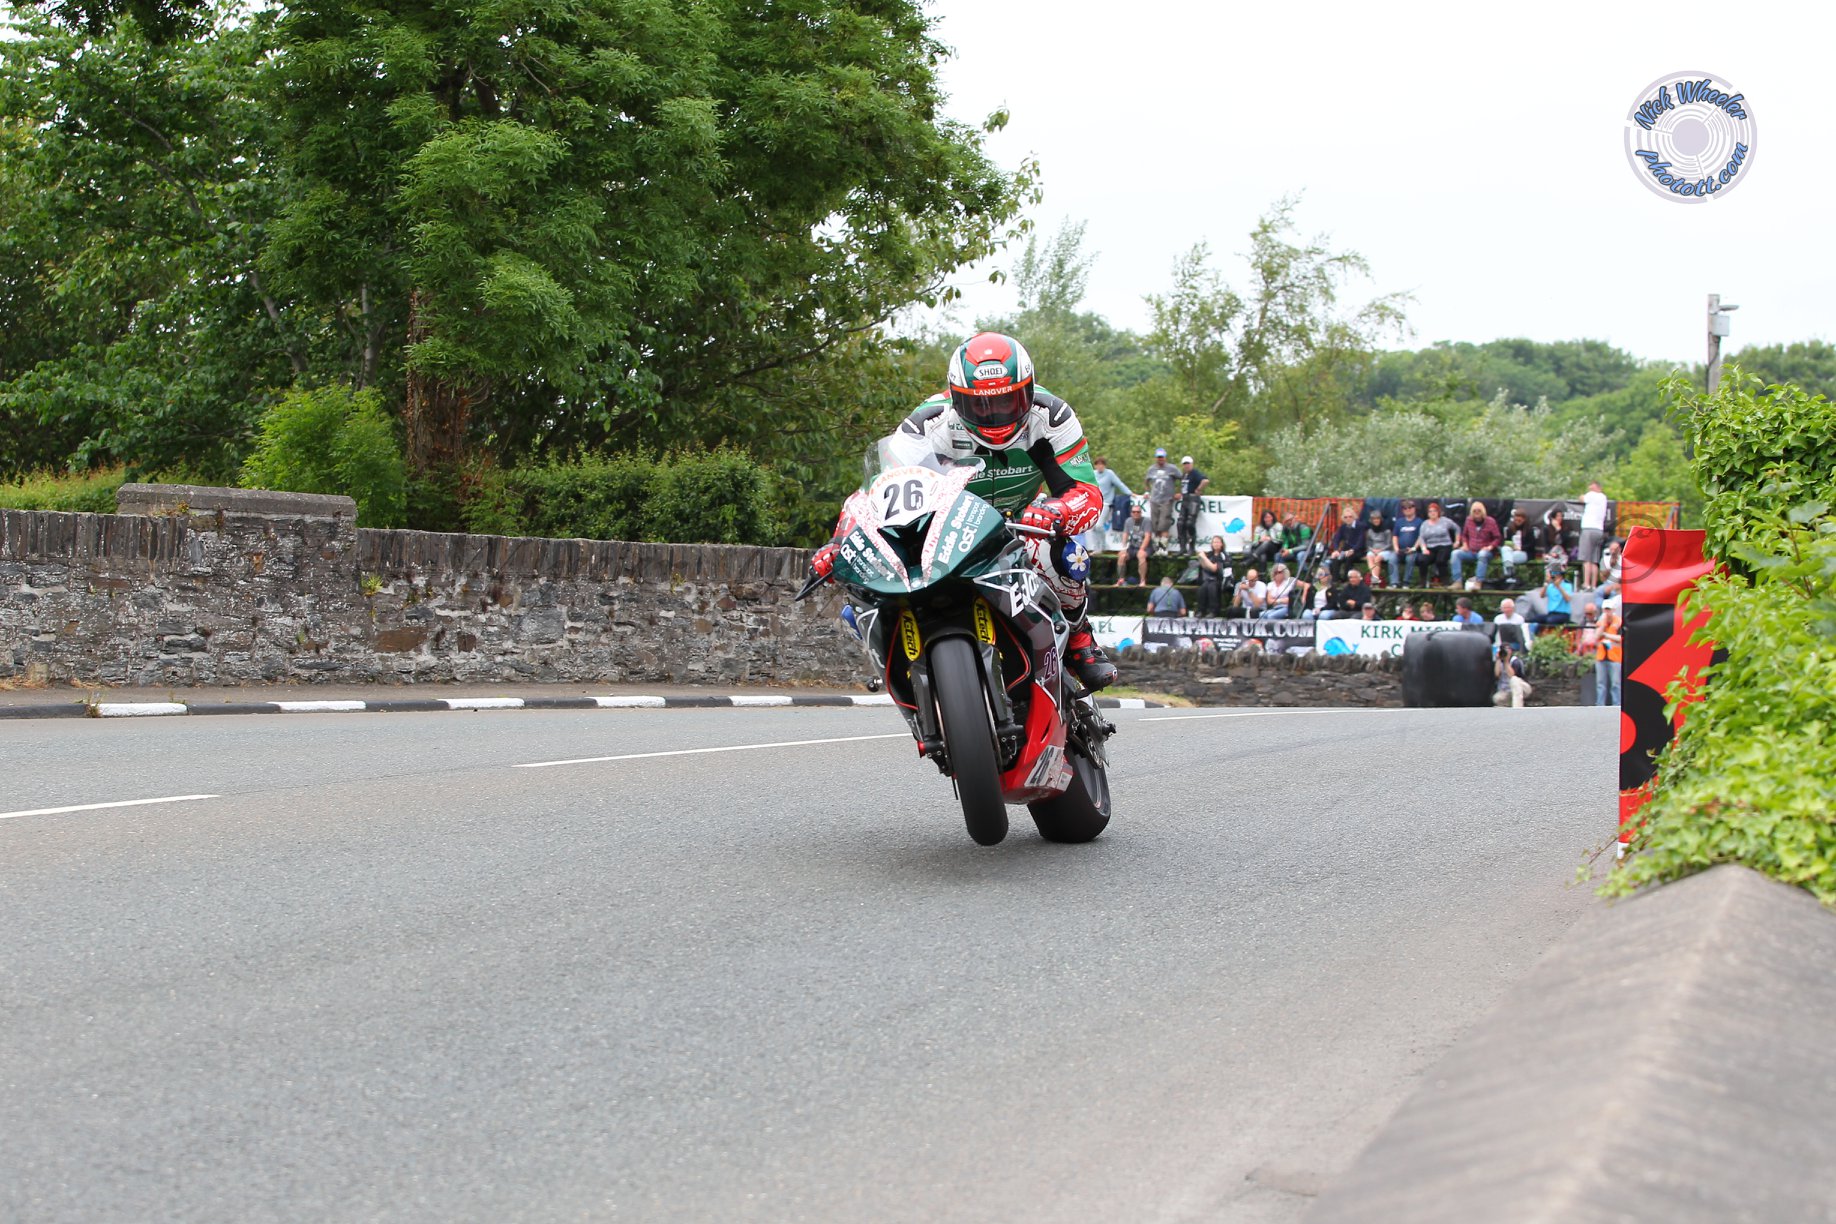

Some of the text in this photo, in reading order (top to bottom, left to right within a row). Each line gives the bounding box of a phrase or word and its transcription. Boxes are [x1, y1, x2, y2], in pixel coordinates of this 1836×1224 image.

[979, 367, 1003, 377] SHOEI
[973, 385, 1013, 396] LANGVER
[987, 465, 1033, 478] Stobart
[883, 479, 924, 520] 26
[938, 494, 974, 564] Eddie Stobart
[862, 548, 895, 581] Stobart
[1361, 625, 1403, 638] KIRK
